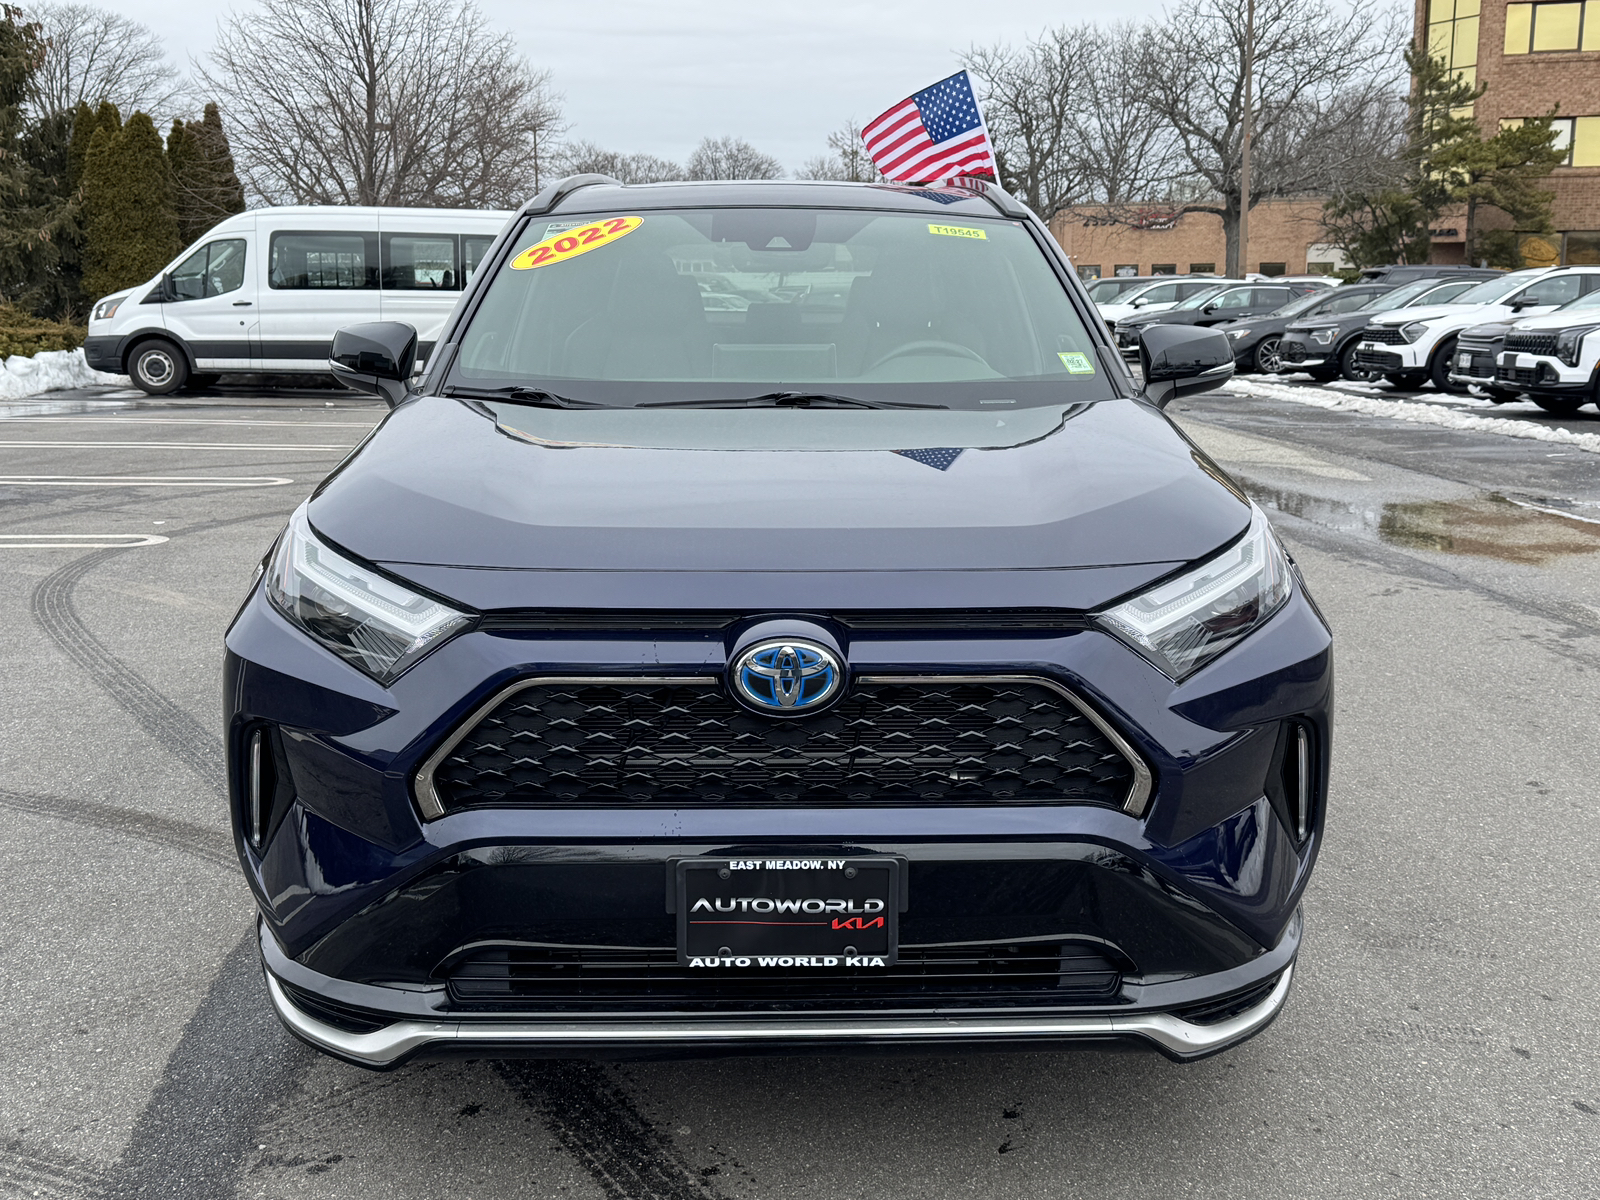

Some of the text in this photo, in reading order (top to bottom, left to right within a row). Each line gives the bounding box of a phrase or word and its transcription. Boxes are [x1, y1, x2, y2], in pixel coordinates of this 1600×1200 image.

[933, 226, 980, 238] T19545
[527, 218, 632, 266] 2022
[729, 860, 762, 870] EAST
[827, 860, 846, 870] NY
[690, 898, 885, 914] AUTOWORLD
[831, 916, 885, 930] KIA
[689, 957, 886, 968] AUTO WORLD KIA
